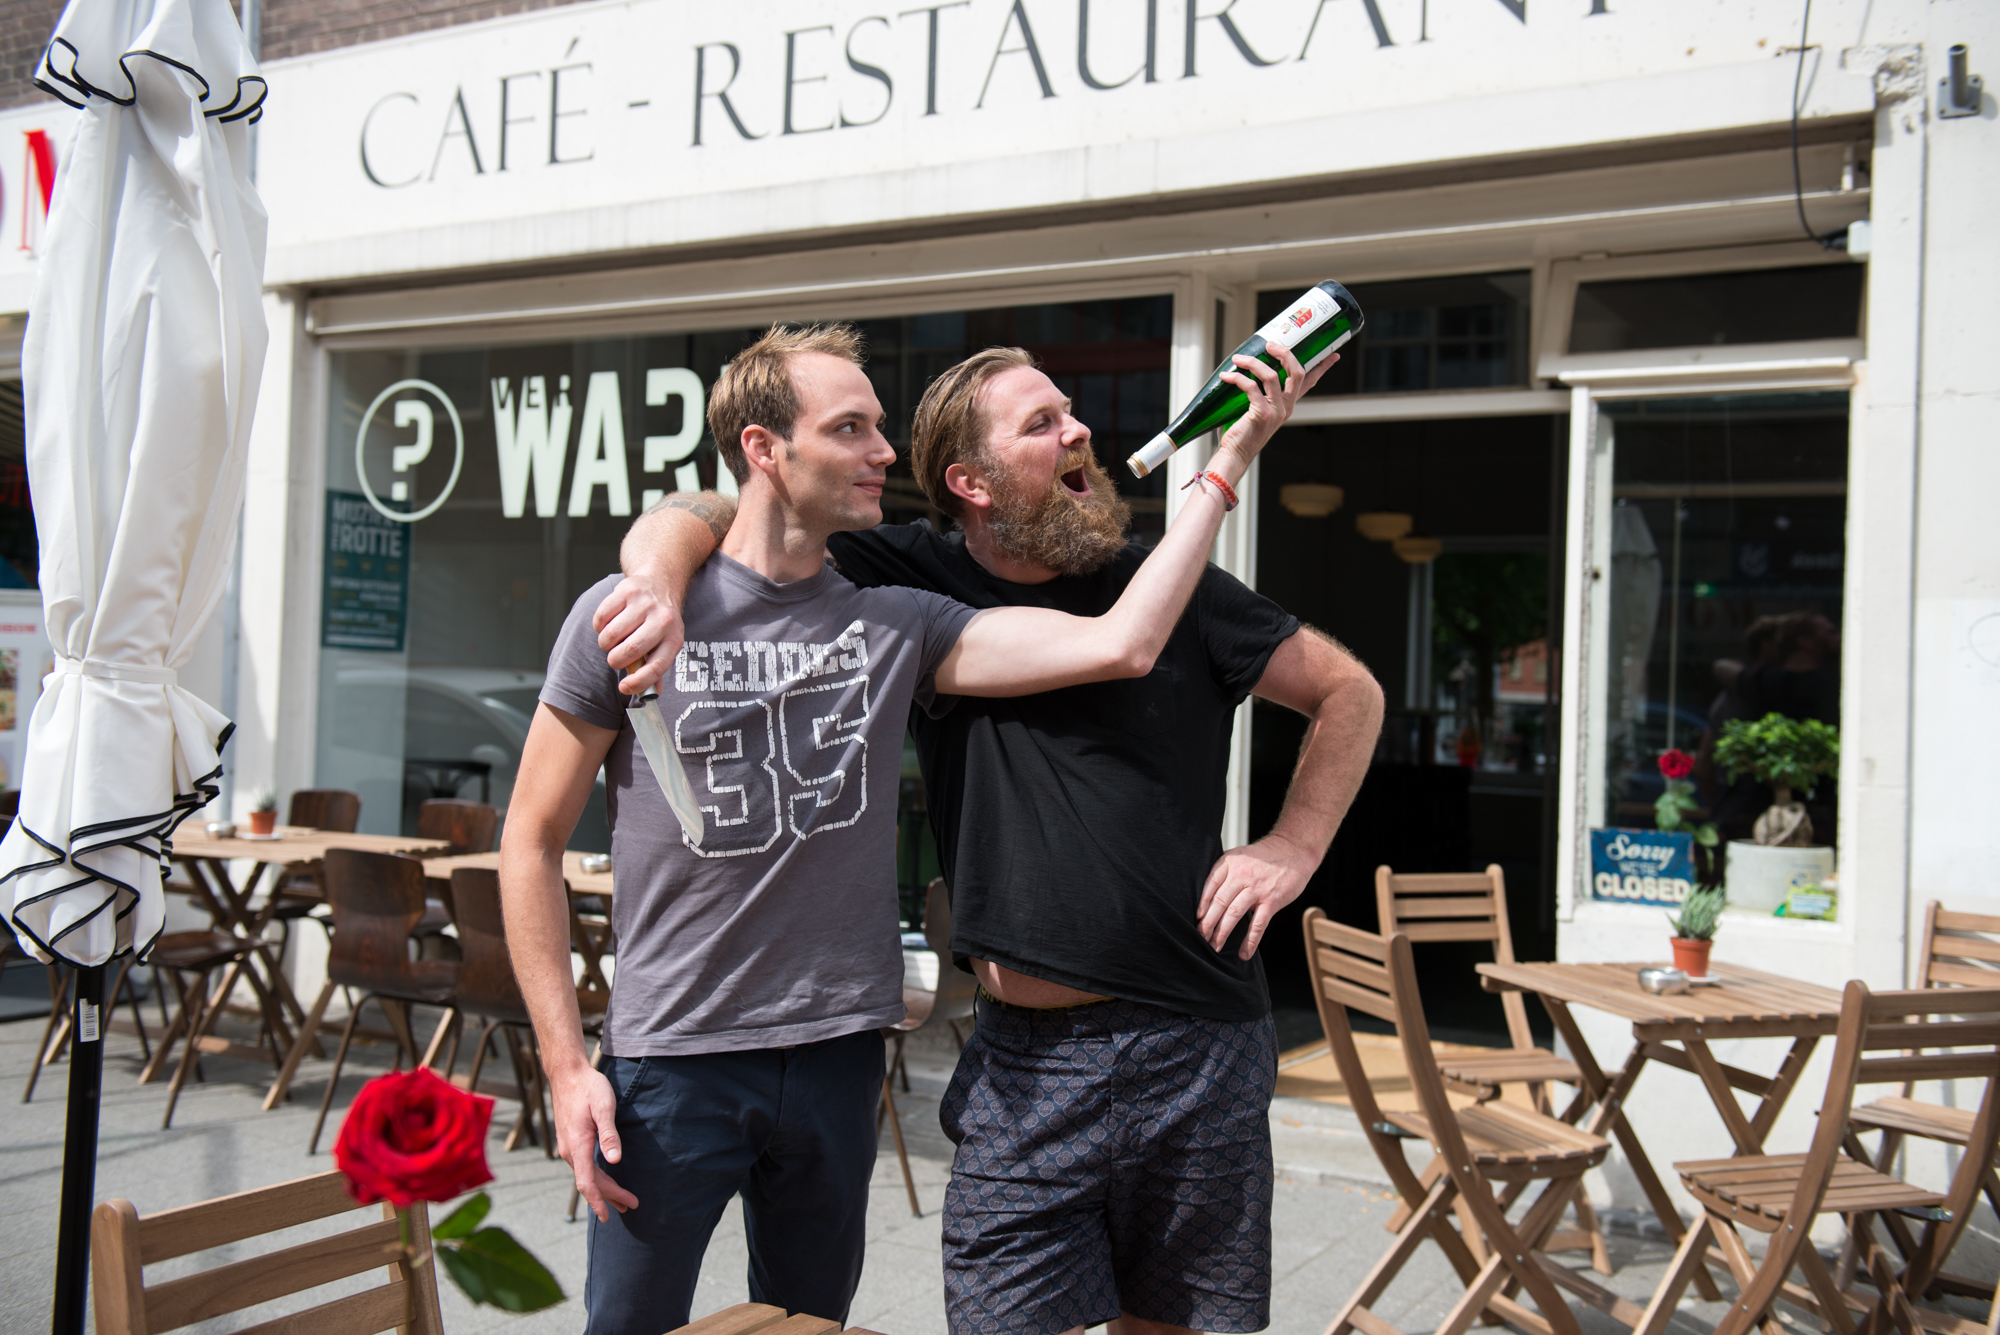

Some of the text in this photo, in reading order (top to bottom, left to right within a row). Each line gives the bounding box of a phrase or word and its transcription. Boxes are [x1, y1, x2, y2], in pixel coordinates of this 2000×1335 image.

[359, 36, 595, 190] CAFÉ
[688, 0, 1618, 148] RESTAURA
[340, 524, 404, 558] ROTTE
[1606, 834, 1675, 870] Sorry
[1618, 860, 1659, 877] WE'RE
[1595, 872, 1691, 904] CLOSED
